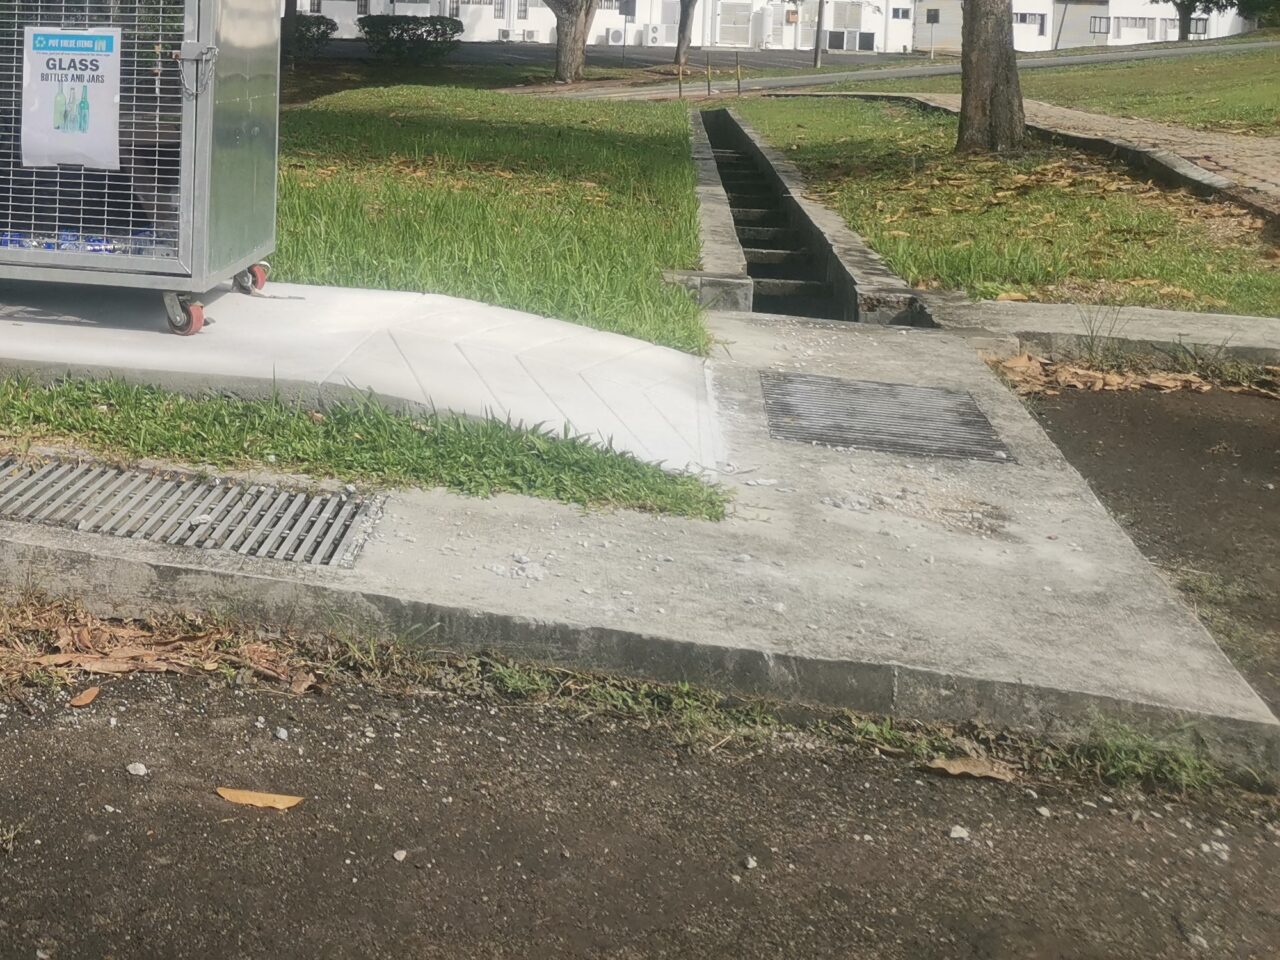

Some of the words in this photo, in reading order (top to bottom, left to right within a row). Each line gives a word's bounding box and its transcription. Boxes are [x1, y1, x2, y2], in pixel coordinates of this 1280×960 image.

[46, 58, 100, 71] GLASS
[40, 73, 68, 83] BOTTLES
[71, 74, 85, 83] AND
[86, 74, 105, 83] JARS
